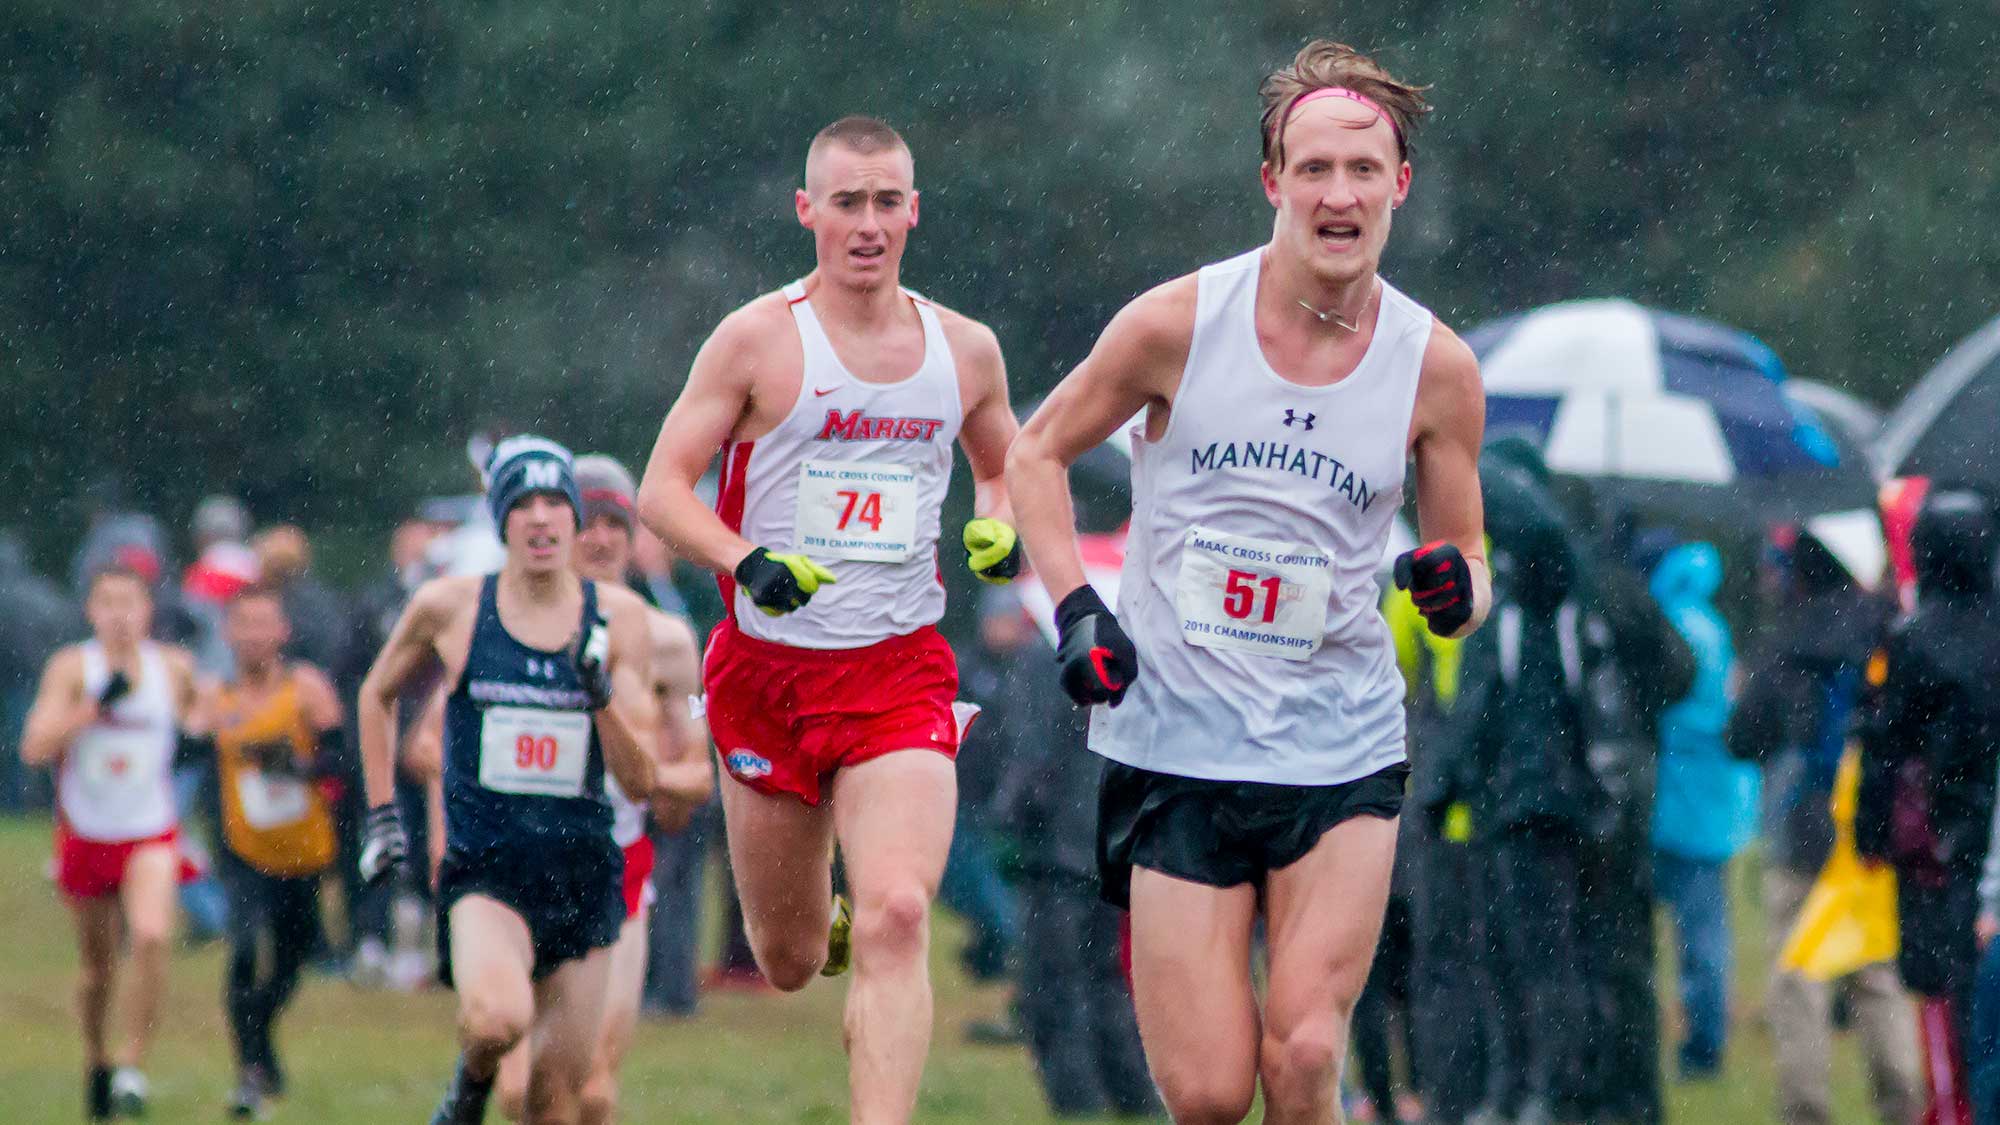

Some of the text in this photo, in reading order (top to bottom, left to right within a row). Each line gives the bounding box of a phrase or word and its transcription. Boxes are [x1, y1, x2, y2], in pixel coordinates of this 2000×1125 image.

[814, 408, 945, 443] MARIST
[525, 461, 560, 488] M
[808, 469, 914, 483] MAAC CROSS COUNTRY
[1191, 442, 1377, 514] MANHATTAN
[836, 490, 883, 531] 74
[804, 536, 907, 551] 2018 CHAMPIONSHIPS
[1193, 538, 1329, 568] MAAC CROSS COUNTRY
[1223, 569, 1282, 624] 51
[1184, 620, 1313, 650] 2018 CHAMPIONSHIPS
[515, 734, 558, 771] 90
